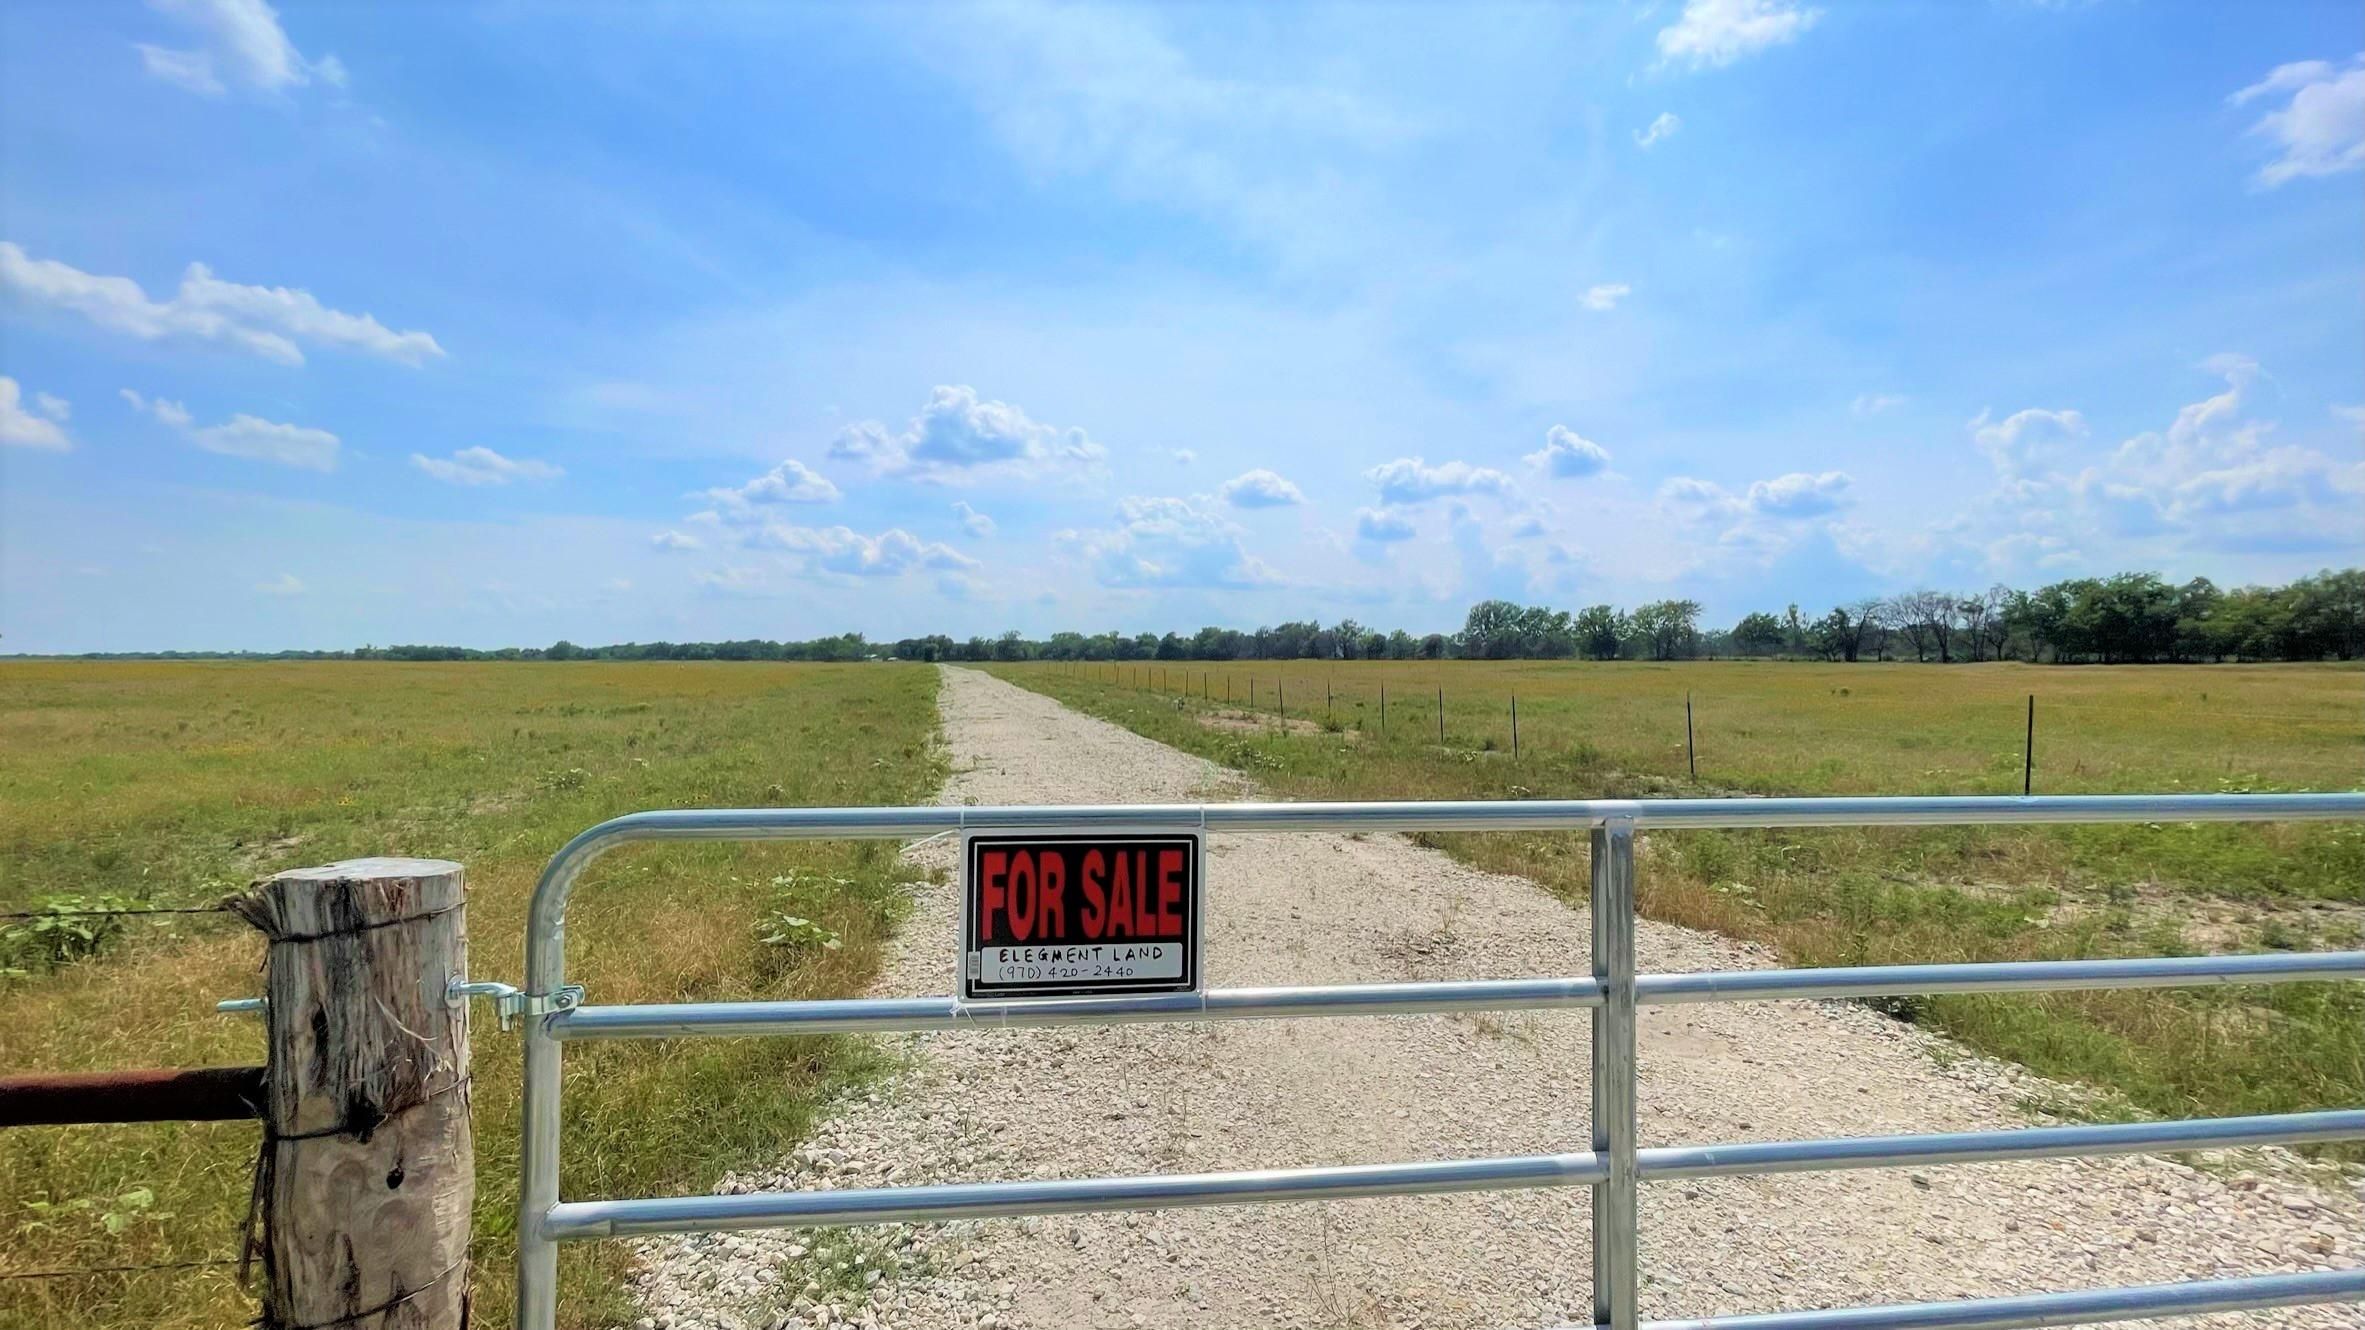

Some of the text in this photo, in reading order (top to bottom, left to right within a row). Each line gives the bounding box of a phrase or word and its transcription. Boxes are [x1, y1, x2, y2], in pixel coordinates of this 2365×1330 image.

[982, 848, 1183, 941] FOR SALE
[1113, 946, 1163, 961] LAND
[998, 964, 1134, 980] (970) 420-2440
